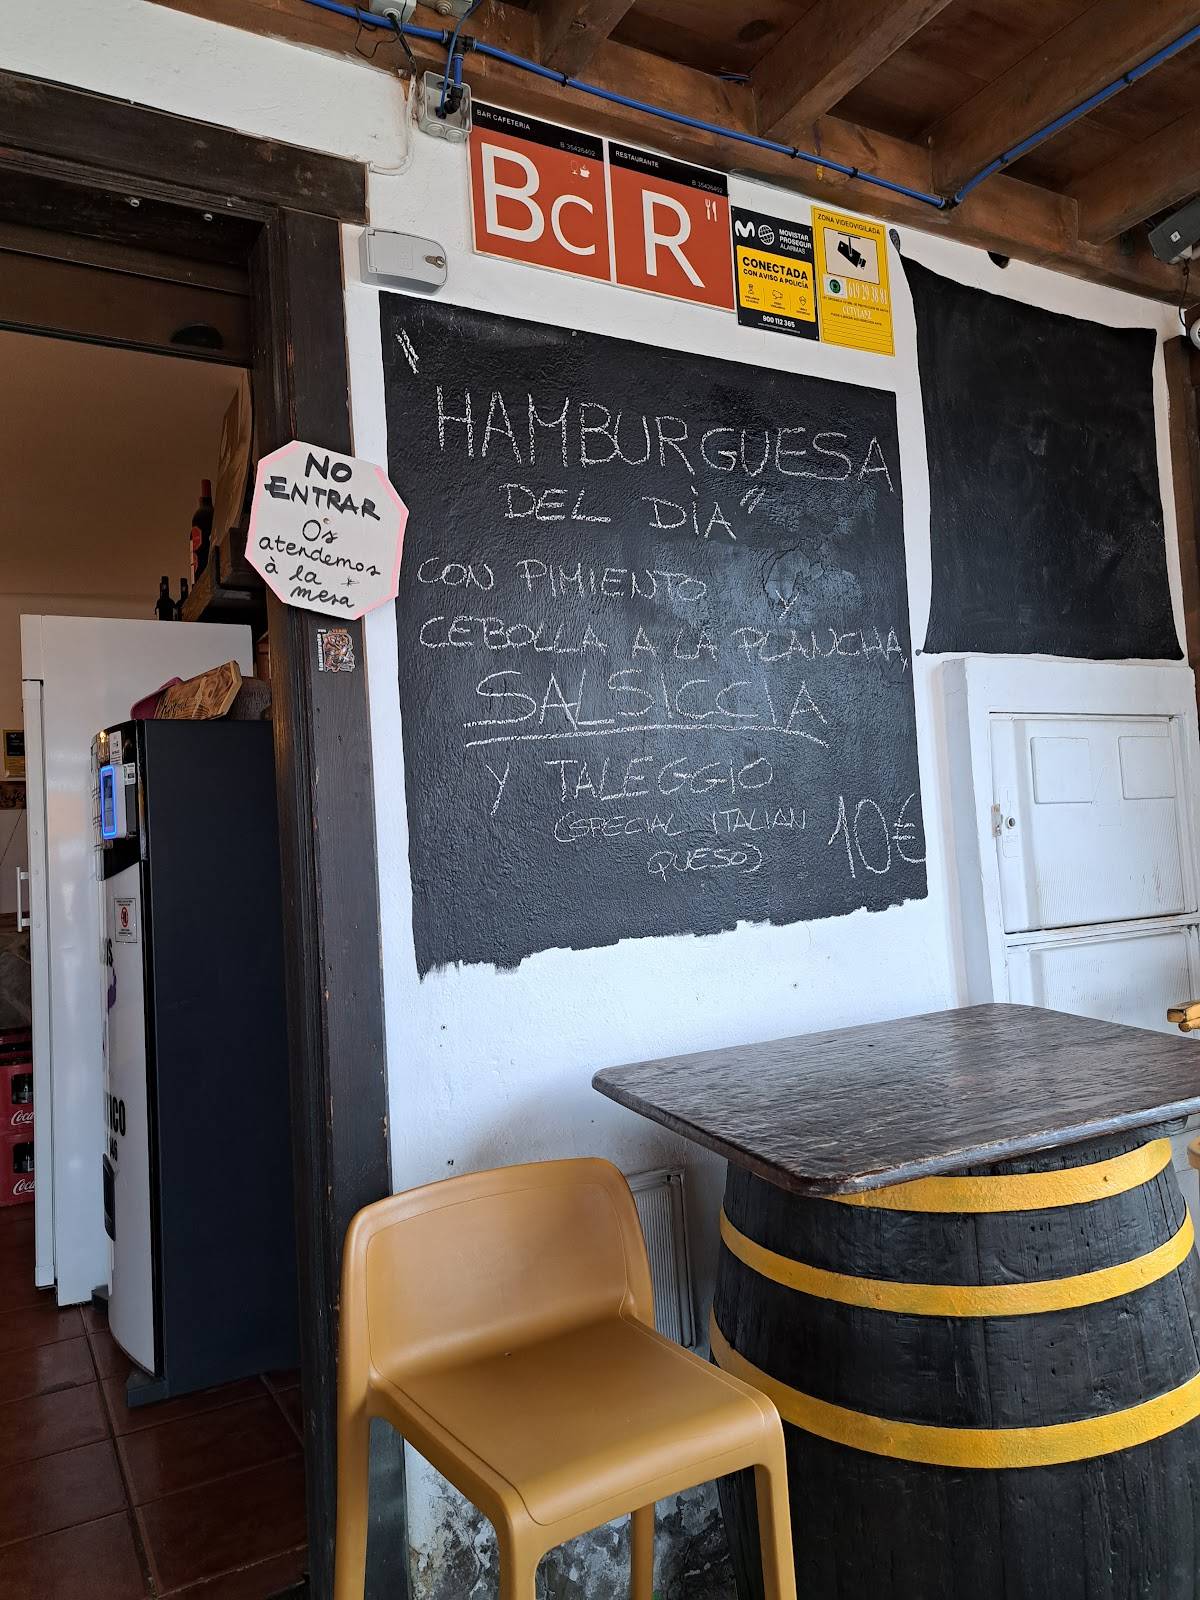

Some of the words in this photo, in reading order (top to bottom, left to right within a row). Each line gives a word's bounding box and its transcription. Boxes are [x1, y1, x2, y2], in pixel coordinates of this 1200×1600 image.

[476, 109, 491, 119] BAR
[615, 150, 660, 168] RESTAURANTE
[778, 228, 809, 241] MOVISTAR
[817, 213, 835, 223] ZONA
[835, 219, 881, 235] VIDEOVIGILADA
[641, 188, 706, 288] R
[779, 235, 812, 249] PROSEGUR
[779, 242, 806, 255] ALARMAS
[742, 256, 808, 281] CONECTADA
[743, 268, 758, 278] CON
[758, 272, 778, 282] AVISO
[784, 278, 809, 289] POLICÍA
[762, 315, 775, 324] 900
[775, 317, 784, 326] 112
[783, 320, 796, 328] 365
[304, 452, 353, 483] NO
[264, 475, 380, 521] ENTRAR
[499, 483, 611, 523] DEL
[302, 519, 338, 544] Os
[259, 535, 381, 576] atendemos
[289, 564, 322, 586] la
[417, 557, 494, 590] CON
[516, 558, 707, 601] PIMIENTO
[290, 585, 355, 609] mesa
[419, 615, 610, 657] CEBOLLA
[631, 624, 660, 659] A
[673, 628, 720, 661] LA
[462, 668, 828, 731] SALSICCIA
[485, 761, 510, 816] Y
[544, 756, 774, 803] TALEGGIO
[712, 807, 807, 836] ITALIAN
[827, 793, 926, 879] 10€
